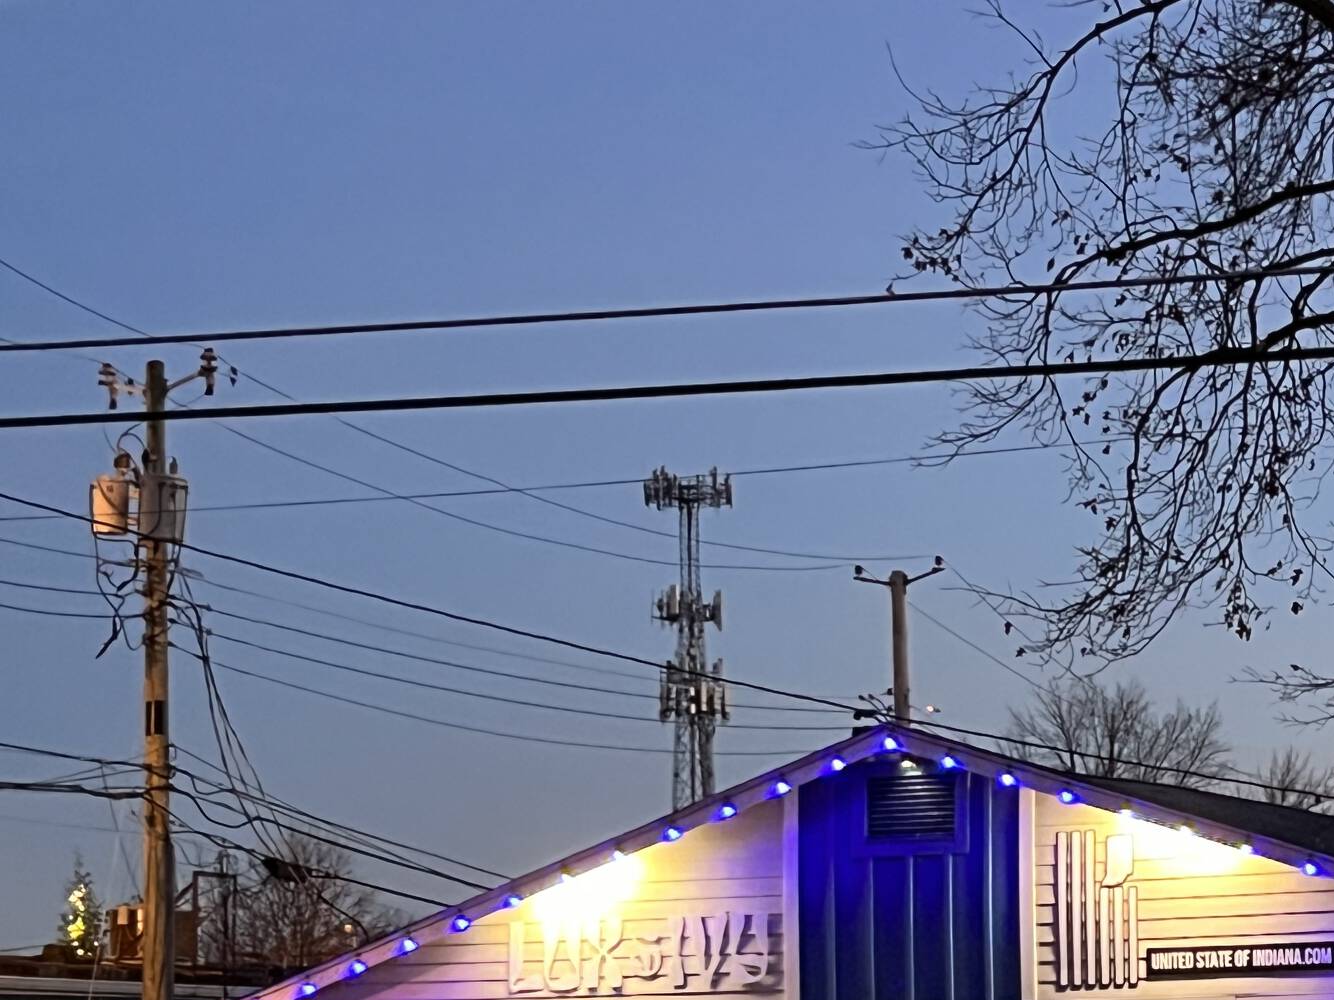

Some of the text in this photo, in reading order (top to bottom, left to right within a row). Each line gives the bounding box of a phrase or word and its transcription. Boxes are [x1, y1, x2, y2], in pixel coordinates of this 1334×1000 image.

[1151, 947, 1332, 970] UNITED STATE OF INDIANA.COM
